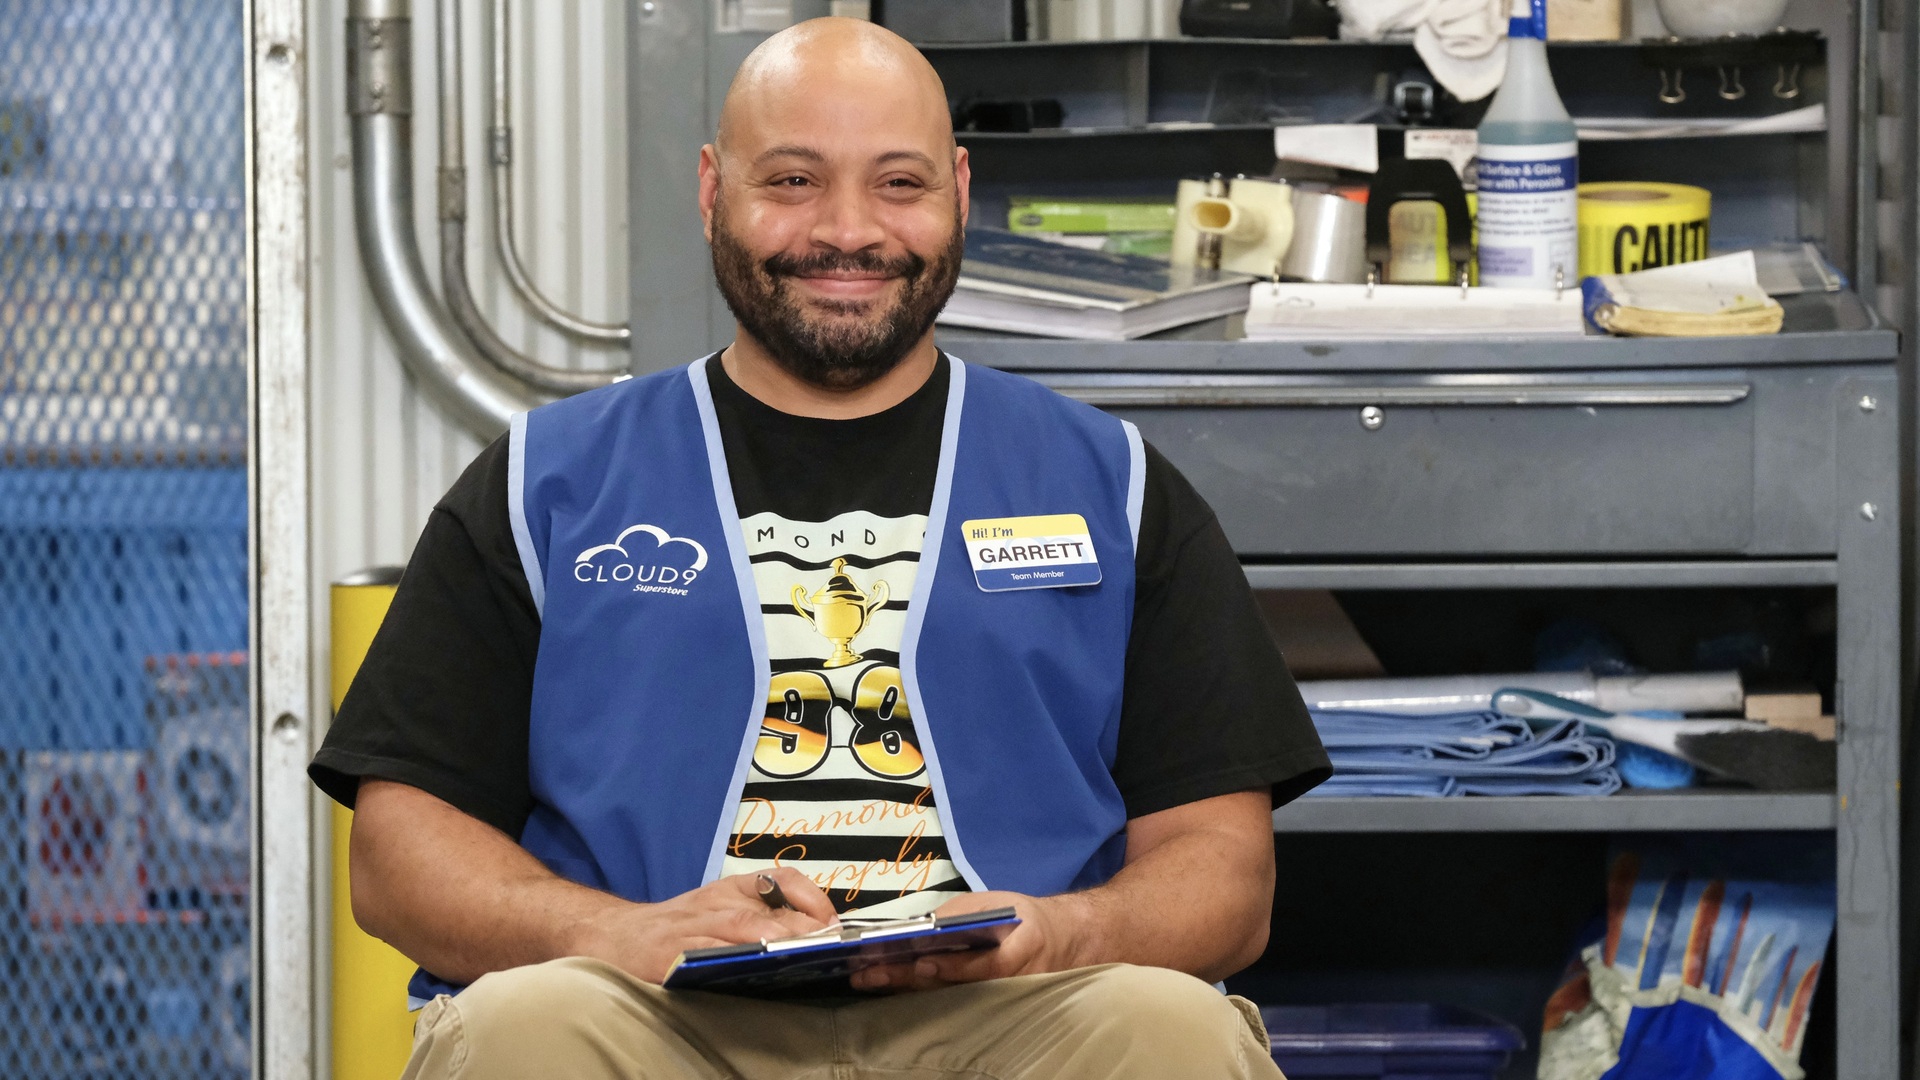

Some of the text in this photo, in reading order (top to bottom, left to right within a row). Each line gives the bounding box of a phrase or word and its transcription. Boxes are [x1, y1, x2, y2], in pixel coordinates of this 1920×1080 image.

[972, 527, 1013, 539] Hi! I'm
[979, 542, 1083, 563] GARRETT
[1010, 570, 1065, 580] Team Member
[633, 584, 688, 596] Superstore
[729, 784, 931, 856] Diamond
